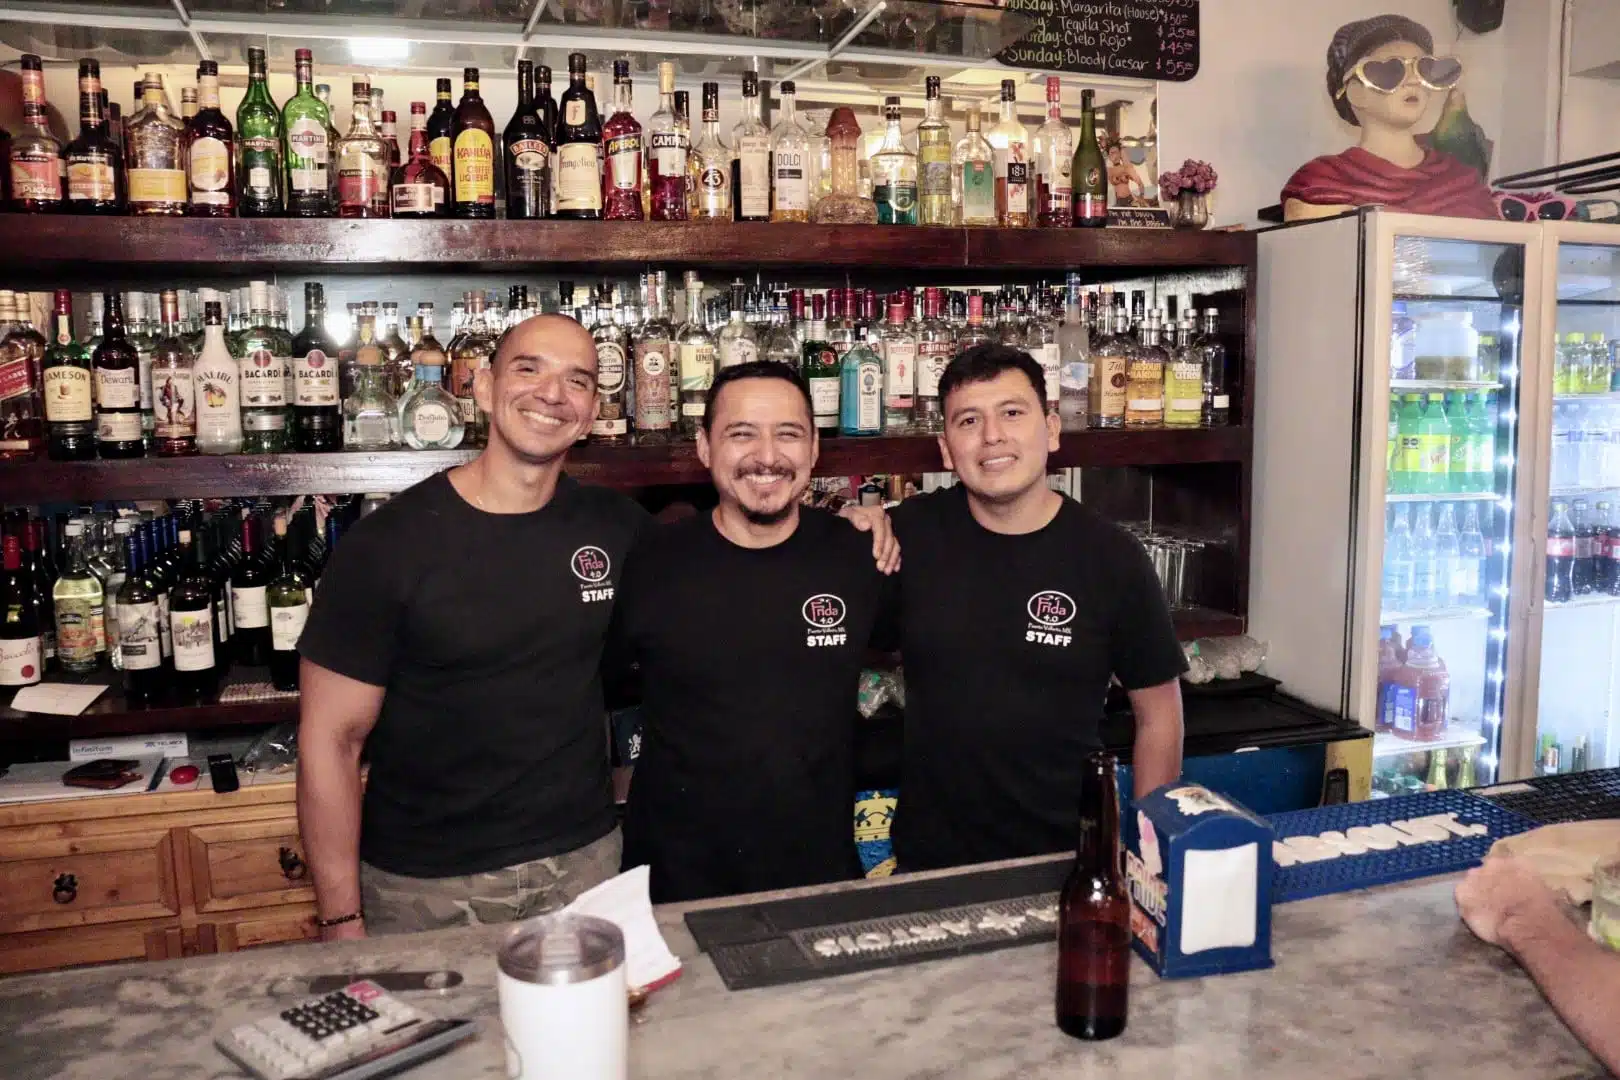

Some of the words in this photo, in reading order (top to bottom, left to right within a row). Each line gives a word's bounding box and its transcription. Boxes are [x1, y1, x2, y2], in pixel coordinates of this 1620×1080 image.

[1061, 0, 1121, 18] Margarita
[1057, 16, 1099, 33] Tequila
[1102, 20, 1131, 33] Shot
[1064, 30, 1096, 46] Cielo
[1007, 46, 1066, 68] Sunday:
[1066, 48, 1106, 71] Bloody
[1108, 53, 1149, 71] Caesar
[608, 138, 640, 153] APEROL
[46, 371, 87, 383] JAMESON
[197, 371, 232, 385] MALIBU
[577, 551, 604, 577] Frida
[582, 588, 615, 602] STAFF
[810, 598, 839, 622] Frida
[1036, 595, 1067, 617] Frida
[807, 634, 847, 647] STAFF
[1025, 630, 1072, 647] STAFF
